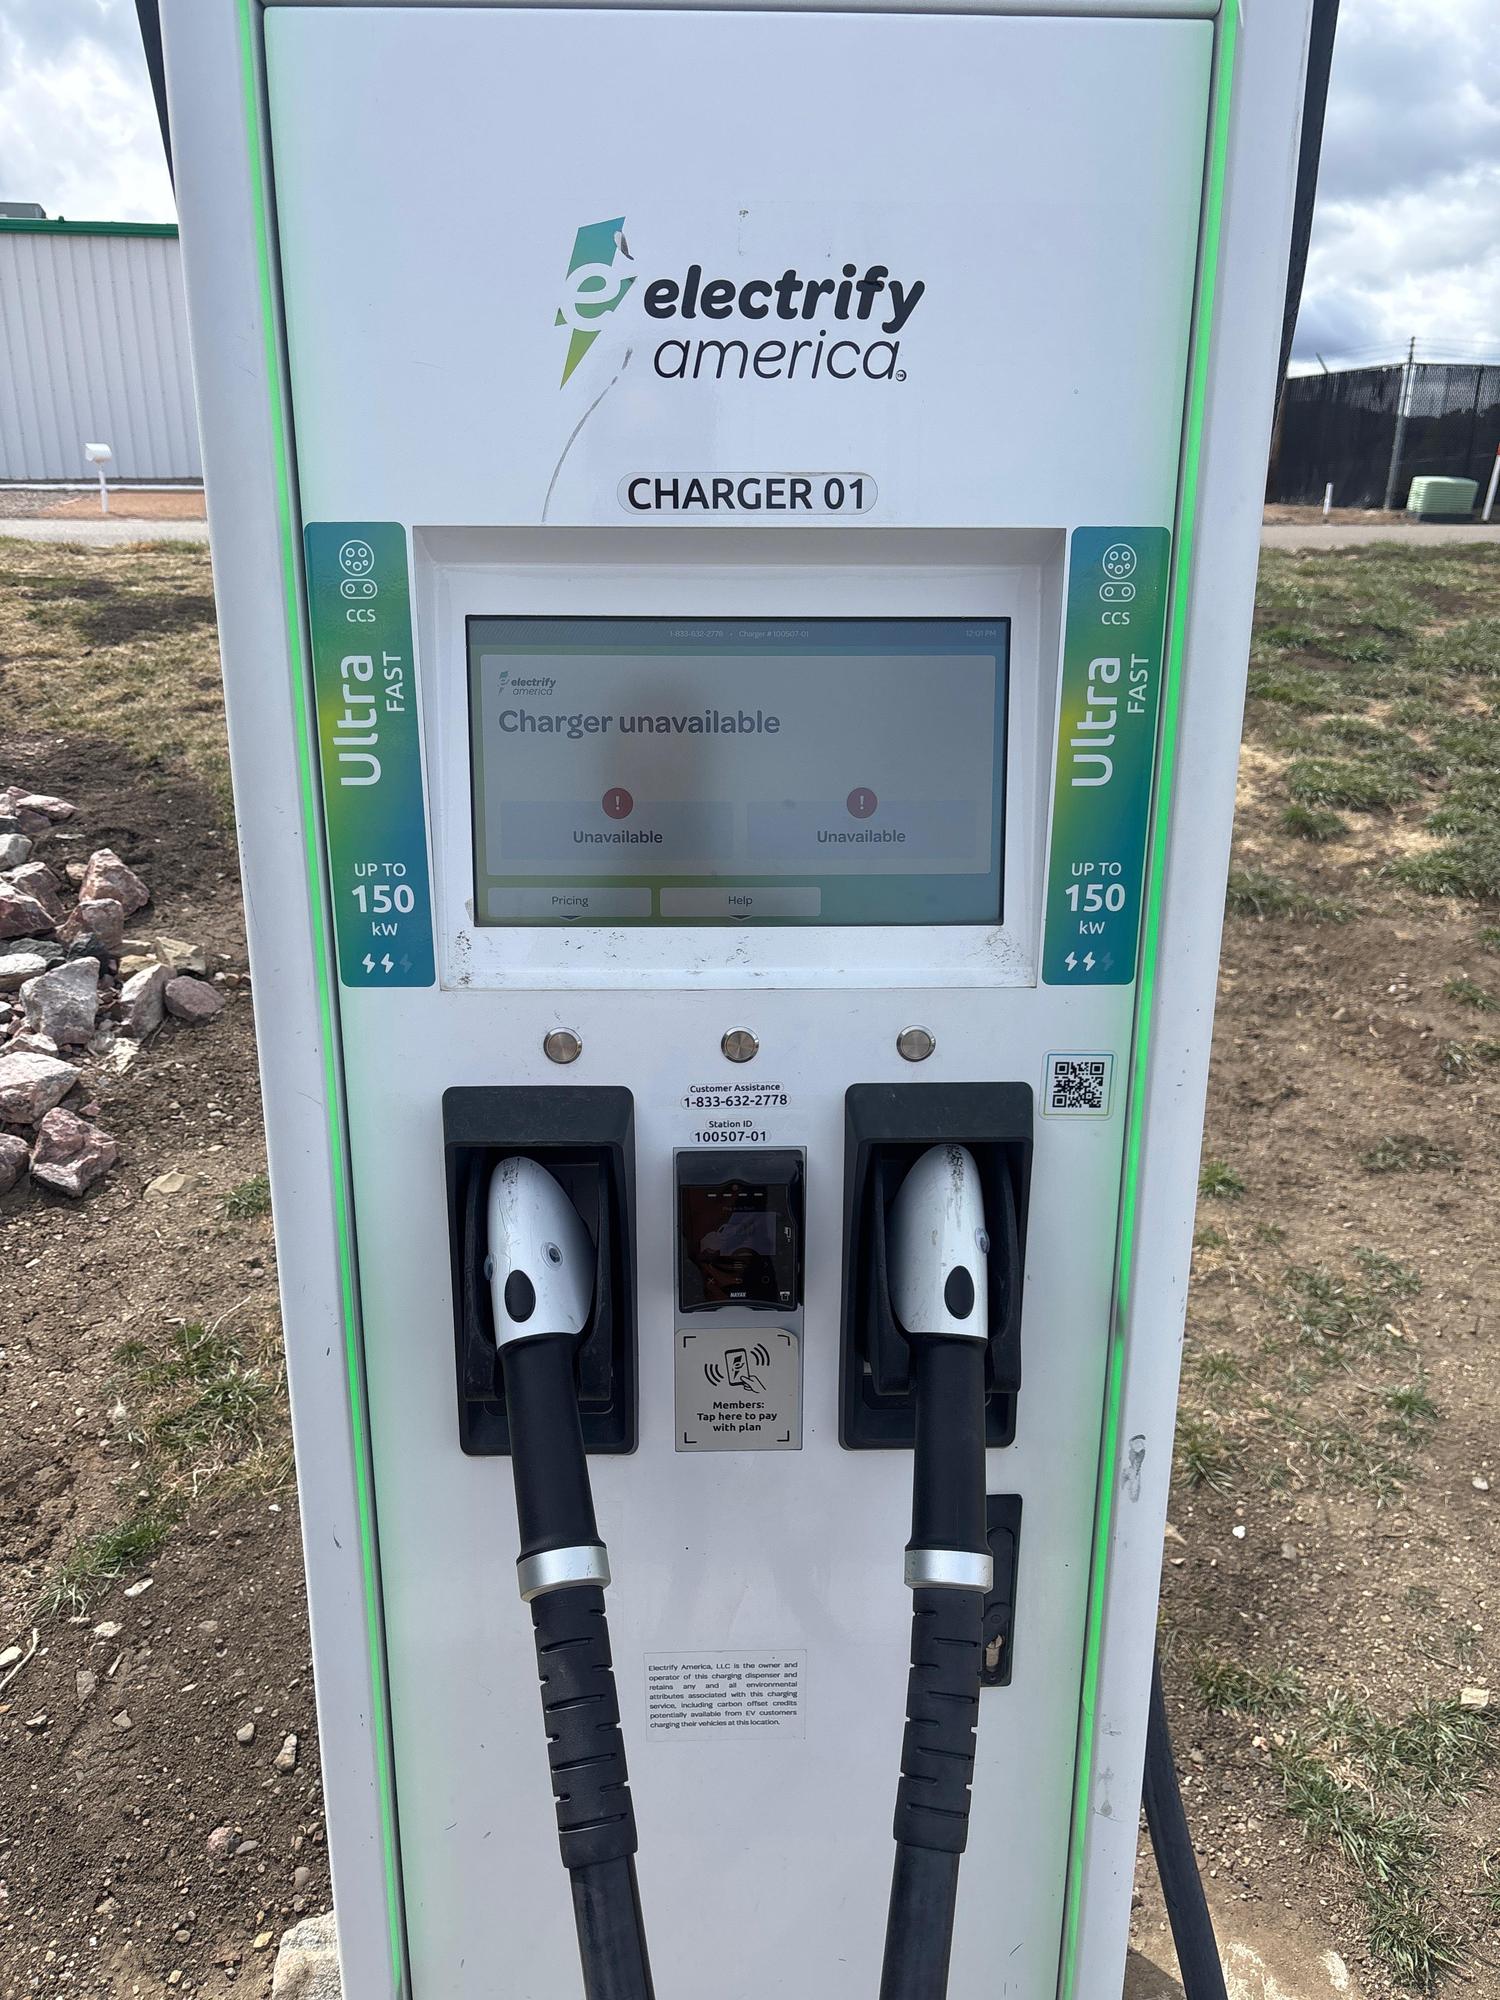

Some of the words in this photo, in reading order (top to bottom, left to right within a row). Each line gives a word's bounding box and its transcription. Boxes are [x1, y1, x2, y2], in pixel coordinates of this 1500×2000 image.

[643, 263, 925, 334] electrify
[653, 329, 900, 379] america
[627, 478, 812, 510] CHARGER
[823, 478, 863, 510] 01
[346, 609, 376, 622] CCS
[1101, 612, 1130, 625] CCS
[382, 651, 405, 712] FAST
[511, 678, 556, 688] electrify
[1127, 654, 1149, 713] FAST
[513, 687, 553, 696] america
[333, 655, 381, 785] Ultra
[498, 709, 613, 739] Charger
[620, 709, 781, 734] unavailable
[1071, 657, 1121, 786] Ultra
[573, 830, 663, 844] Unavailable
[817, 830, 906, 843] Unavailable
[354, 863, 377, 876] UP
[382, 863, 406, 876] TO
[1071, 863, 1094, 876] UP
[1099, 862, 1122, 875] TO
[352, 884, 415, 913] 150
[552, 895, 589, 907] Pricing
[728, 895, 753, 906] Help
[1065, 884, 1125, 912] 150
[372, 922, 398, 936] kW
[1079, 921, 1105, 934] kW
[690, 1085, 732, 1093] Customer
[684, 1094, 787, 1107] 1-833-632-2778
[695, 1131, 766, 1142] 100507-01
[713, 1401, 764, 1409] Members:
[697, 1413, 715, 1422] Tap
[759, 1413, 777, 1421] pay
[713, 1423, 736, 1431] with
[739, 1423, 761, 1432] plan
